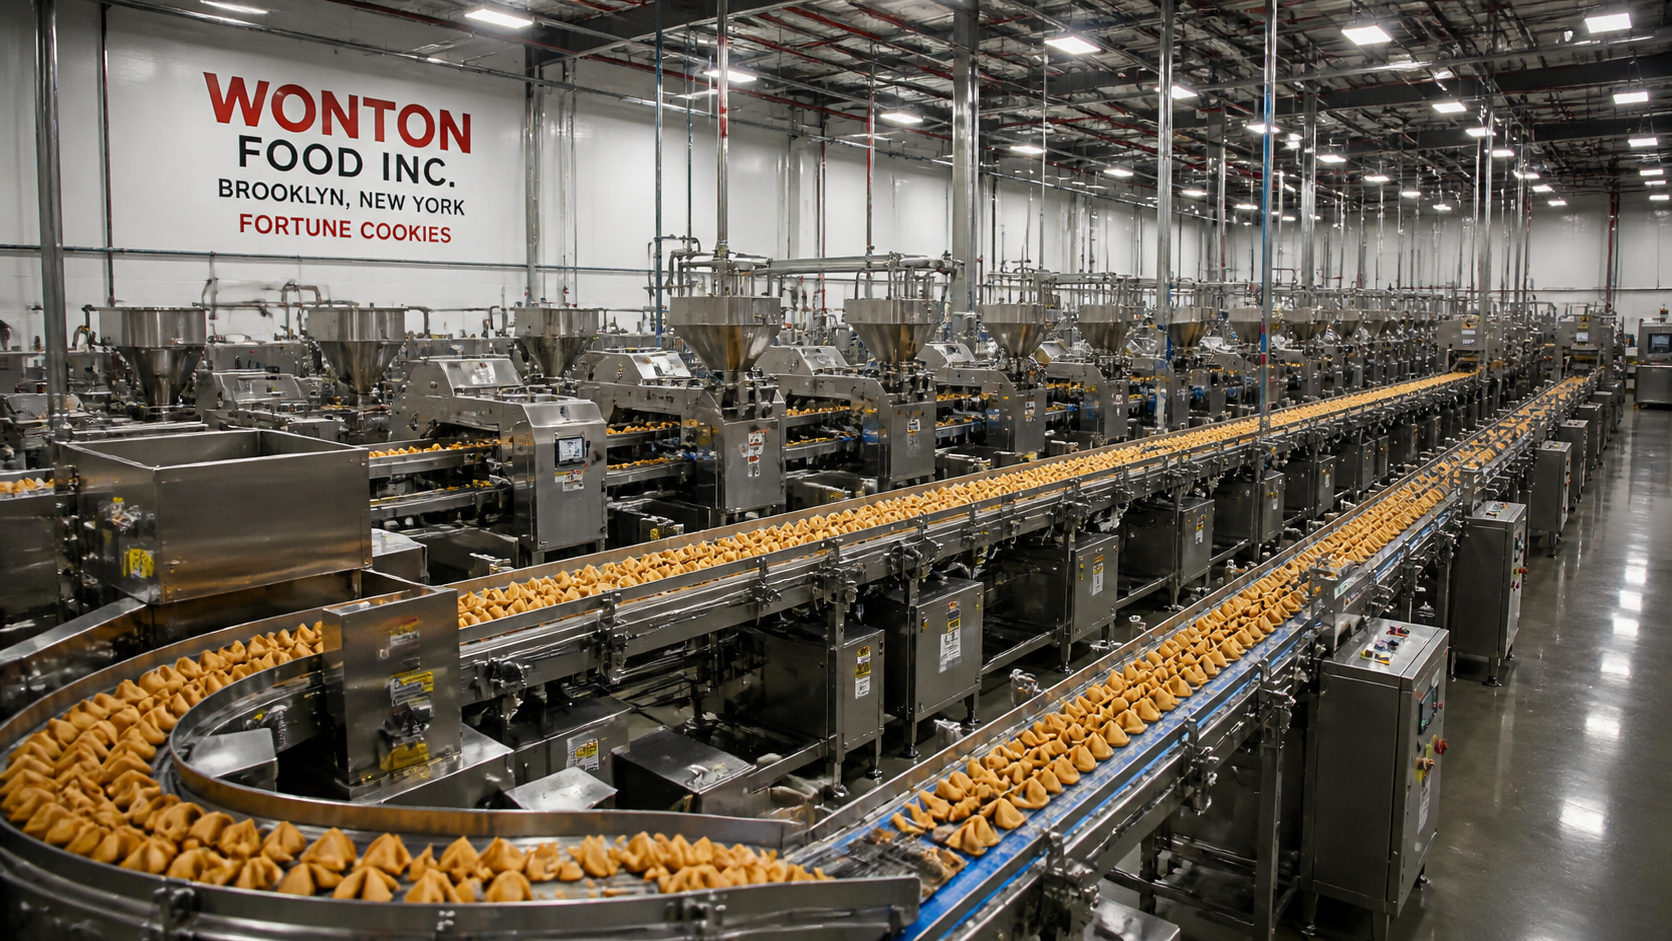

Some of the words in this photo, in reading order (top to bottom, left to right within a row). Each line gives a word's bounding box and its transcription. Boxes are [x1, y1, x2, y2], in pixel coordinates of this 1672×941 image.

[203, 72, 471, 154] WONTON
[238, 135, 363, 177] FOOD
[383, 152, 455, 187] INC.
[218, 178, 350, 209] BROOKLYN,
[359, 191, 405, 210] NEW
[412, 196, 465, 215] YORK
[239, 213, 352, 238] FORTUNE
[360, 221, 451, 243] COOKIES
